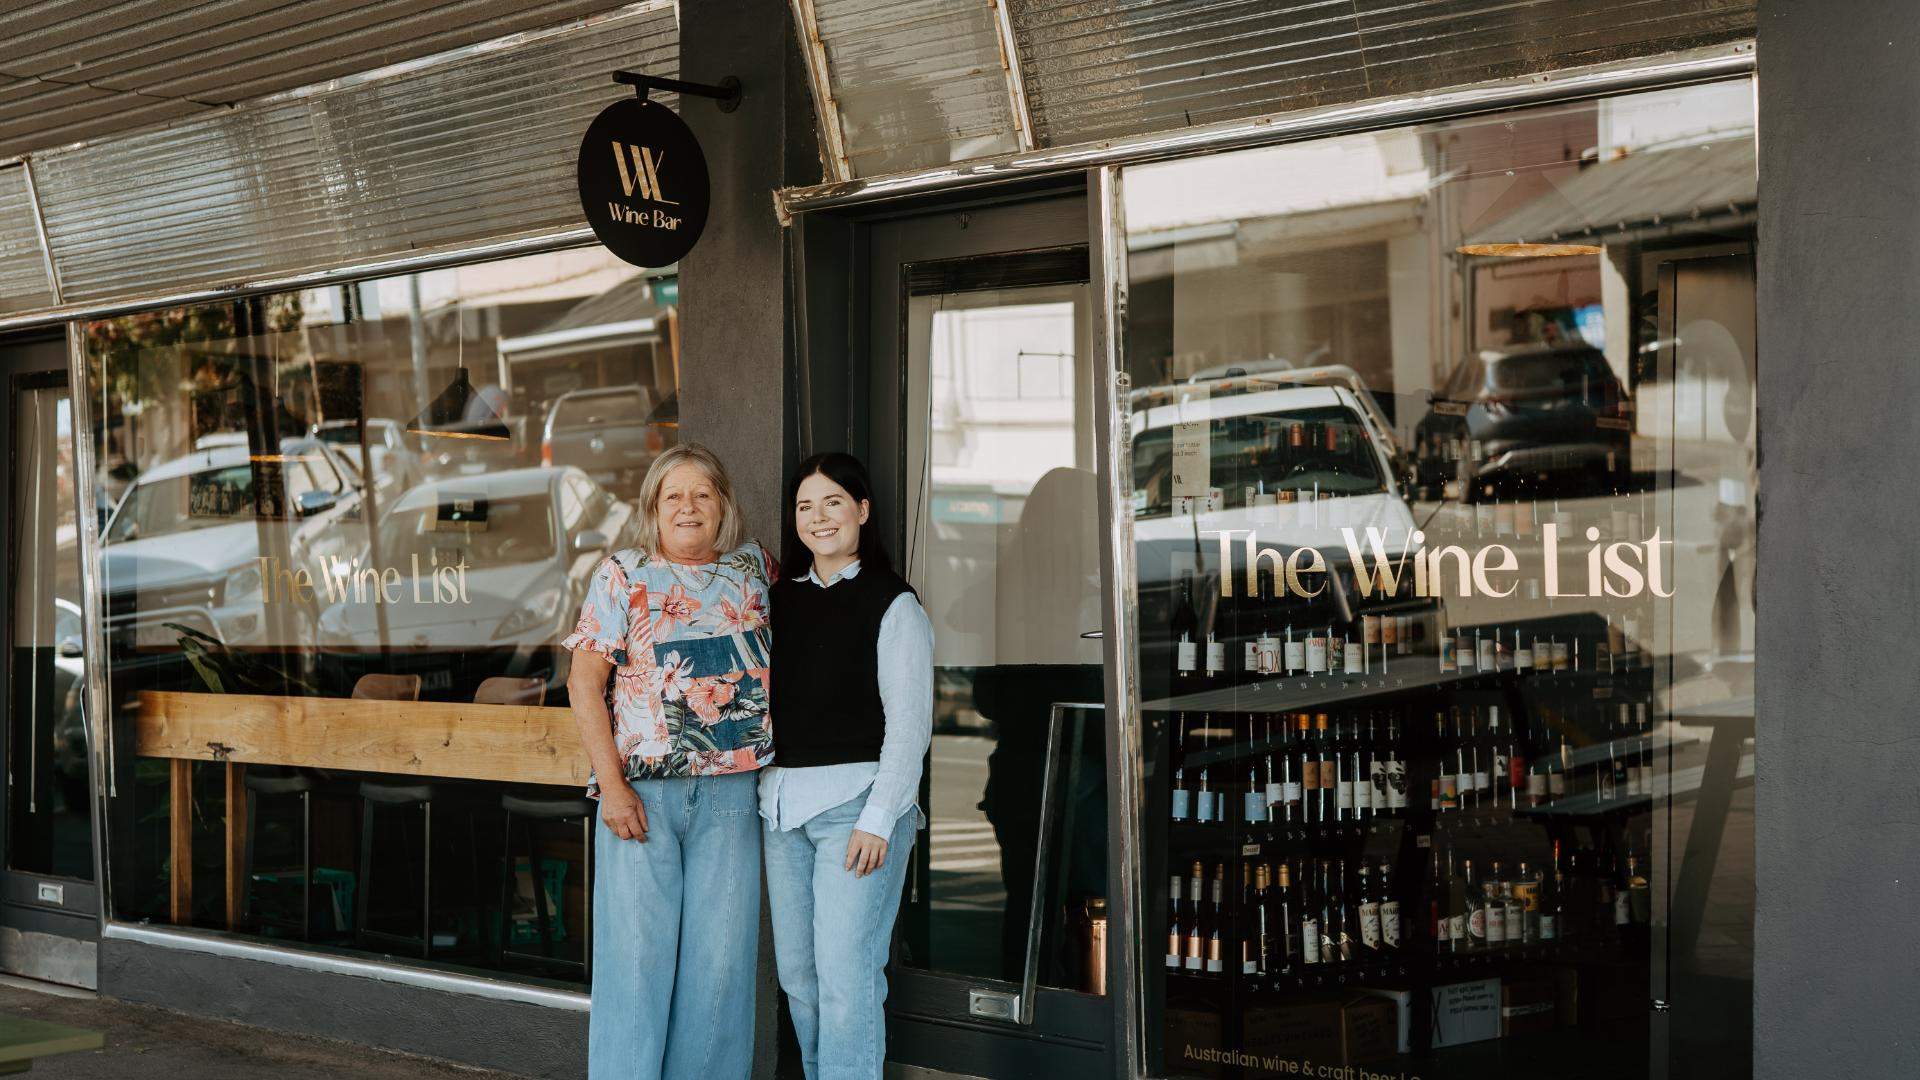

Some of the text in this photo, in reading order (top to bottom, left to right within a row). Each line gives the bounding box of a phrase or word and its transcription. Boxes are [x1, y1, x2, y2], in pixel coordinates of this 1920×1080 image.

[608, 202, 682, 231] Wine Bar
[253, 553, 472, 604] The Wine List
[1200, 523, 1677, 598] The Wine List
[1184, 1044, 1259, 1068] Australian
[1263, 1055, 1299, 1074] wine
[1302, 1060, 1314, 1076] &
[1318, 1065, 1356, 1080] craft
